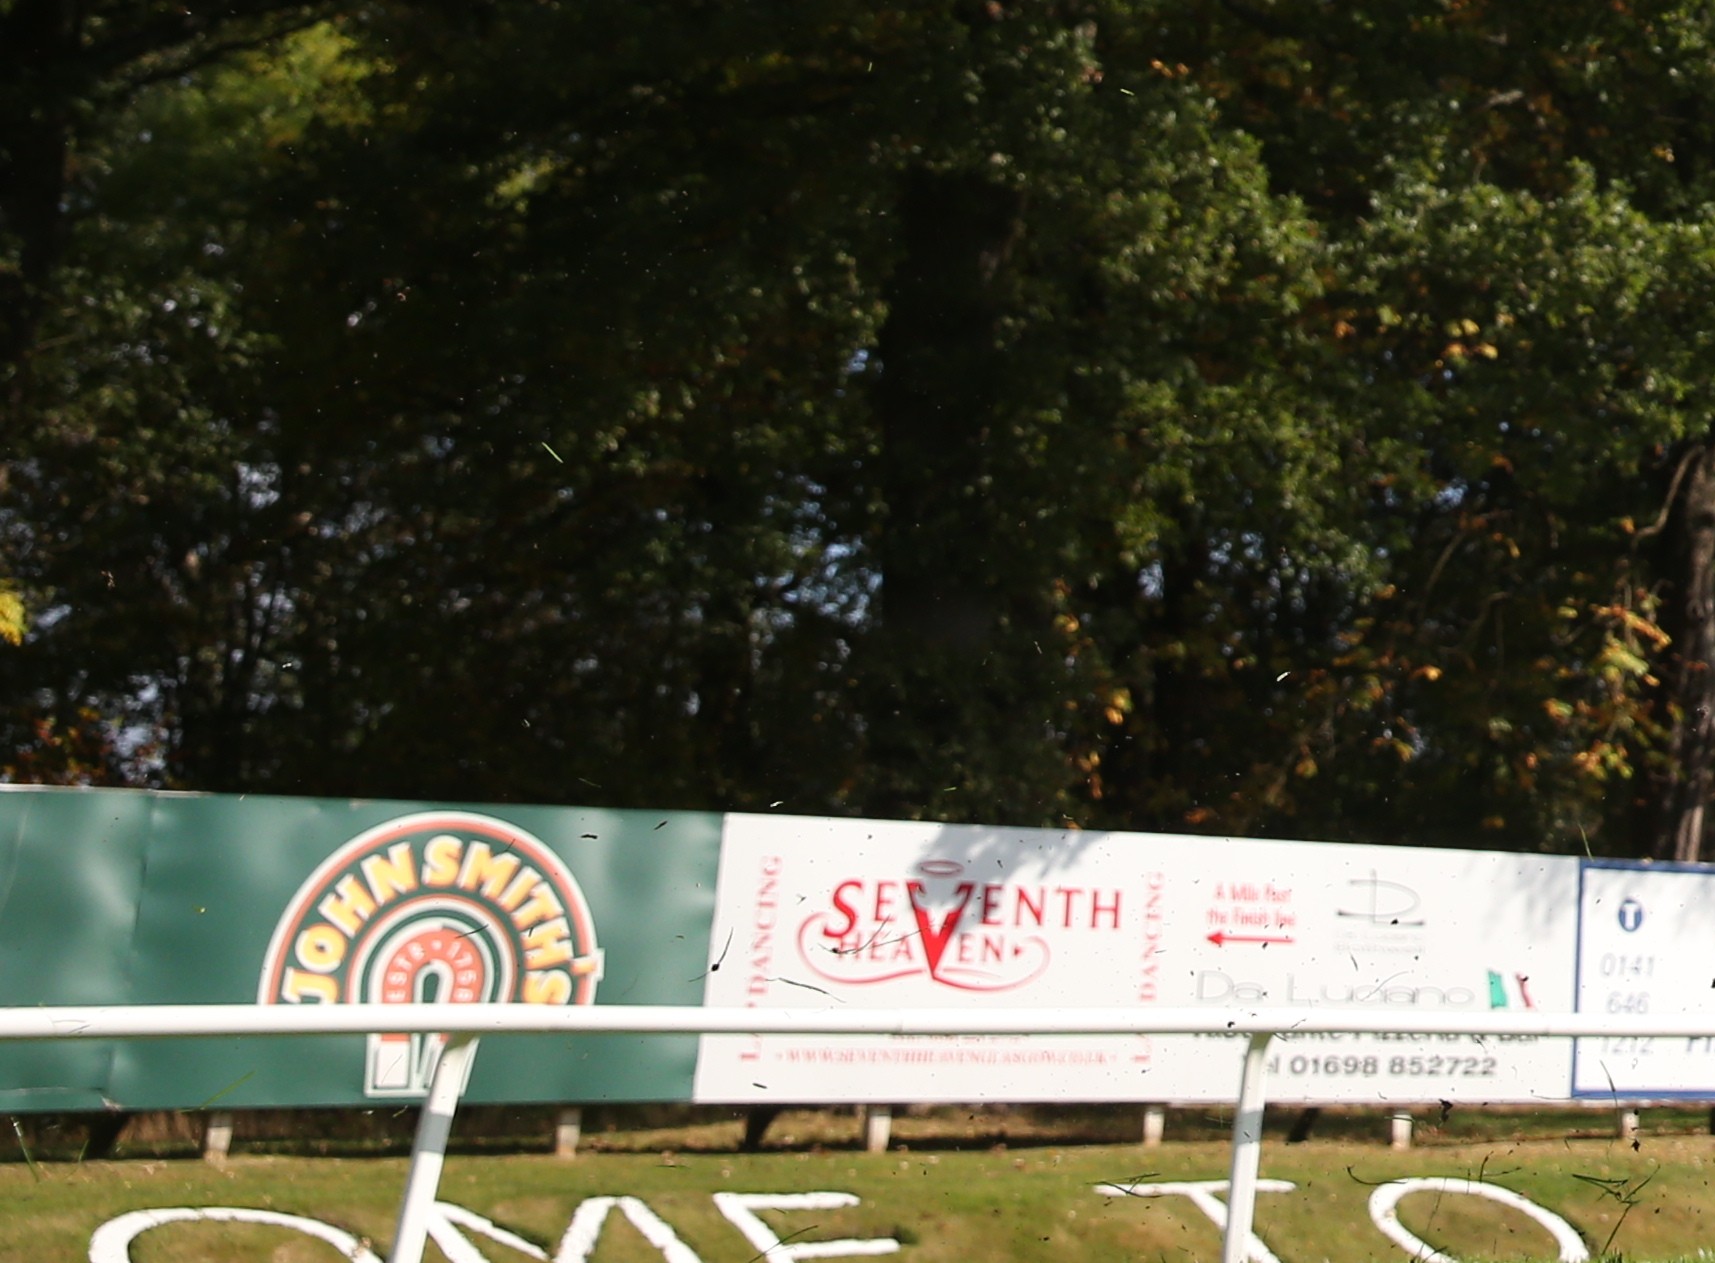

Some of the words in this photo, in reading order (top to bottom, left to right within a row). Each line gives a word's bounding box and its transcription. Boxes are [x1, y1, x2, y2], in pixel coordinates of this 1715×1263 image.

[281, 841, 419, 1004] JOHN
[421, 834, 605, 1004] SMITH'S
[746, 854, 784, 996] DANCING
[822, 878, 1122, 941] SEVENTH
[835, 931, 1004, 968] HEAVEN
[1138, 870, 1165, 1002] DANCING
[1600, 951, 1656, 978] 0141
[1197, 969, 1264, 1004] Da
[1286, 971, 1476, 1006] Luciano
[1605, 990, 1652, 1015] 646
[1290, 1055, 1378, 1076] 01698
[1389, 1055, 1498, 1077] 852722
